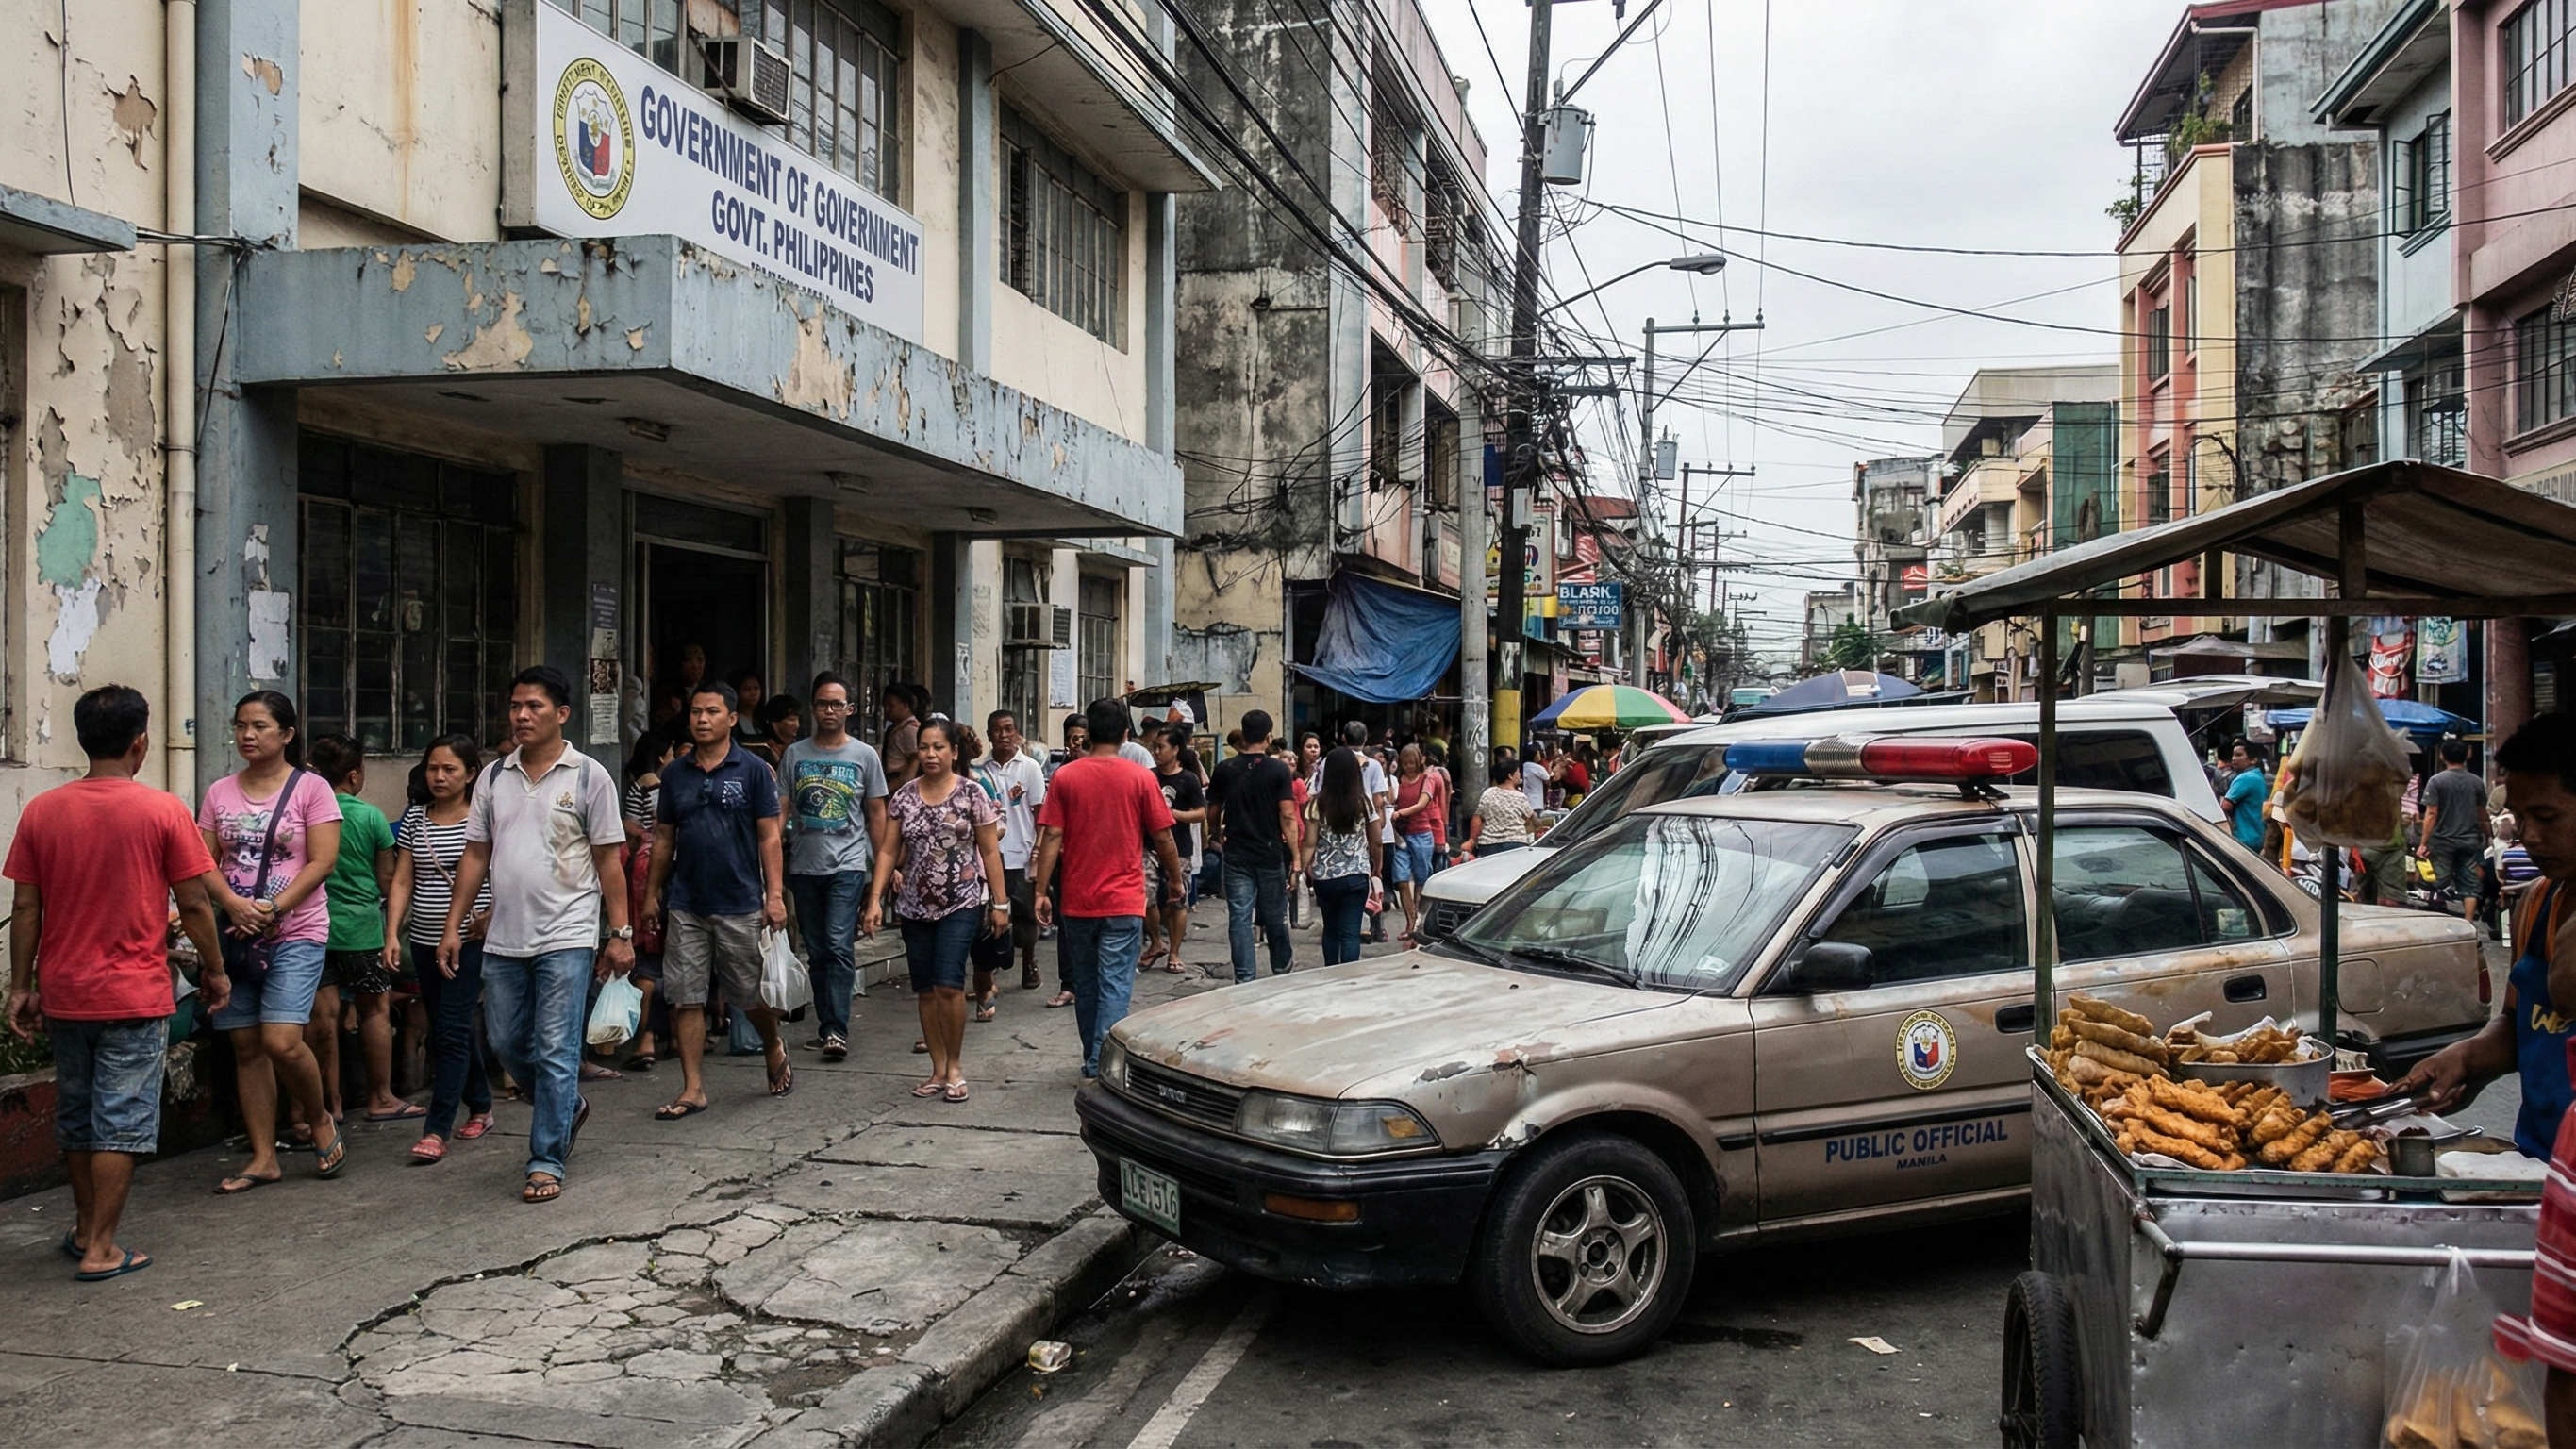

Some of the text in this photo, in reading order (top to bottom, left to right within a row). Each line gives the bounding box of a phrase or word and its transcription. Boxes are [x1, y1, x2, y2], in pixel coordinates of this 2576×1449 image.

[641, 85, 781, 204] GOVERNMENT
[787, 166, 809, 218] OF
[815, 181, 919, 275] GOVERNMENT
[712, 190, 768, 256] GOVT.
[774, 219, 873, 303] PHILIPPINES
[1825, 1119, 2008, 1163] PUBLIC OFFICIAL
[1896, 1153, 1947, 1170] MANILA
